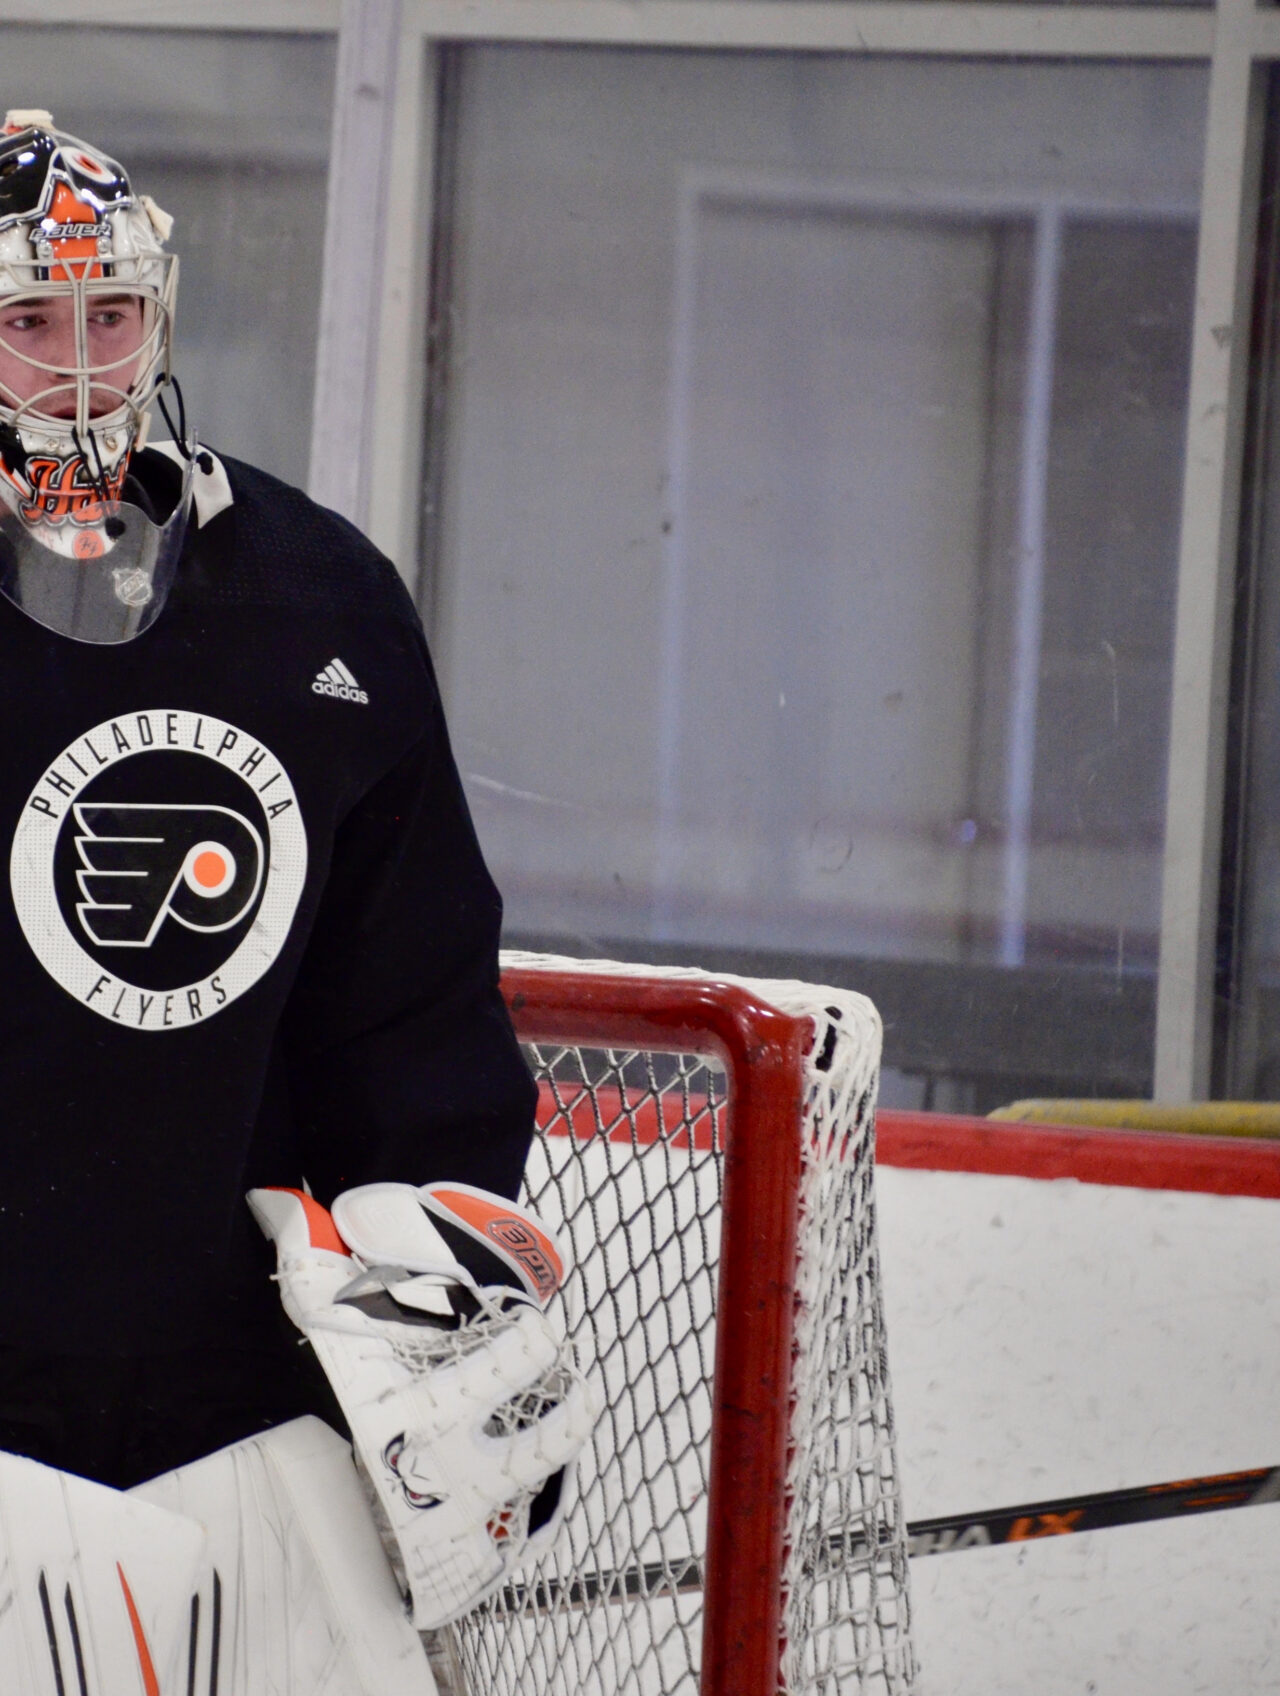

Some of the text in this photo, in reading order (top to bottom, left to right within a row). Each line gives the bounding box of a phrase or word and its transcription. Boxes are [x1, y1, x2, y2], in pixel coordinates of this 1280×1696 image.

[311, 681, 369, 704] adidas
[30, 713, 293, 819] PHILADELPHIA
[85, 974, 227, 1026] FLYERS
